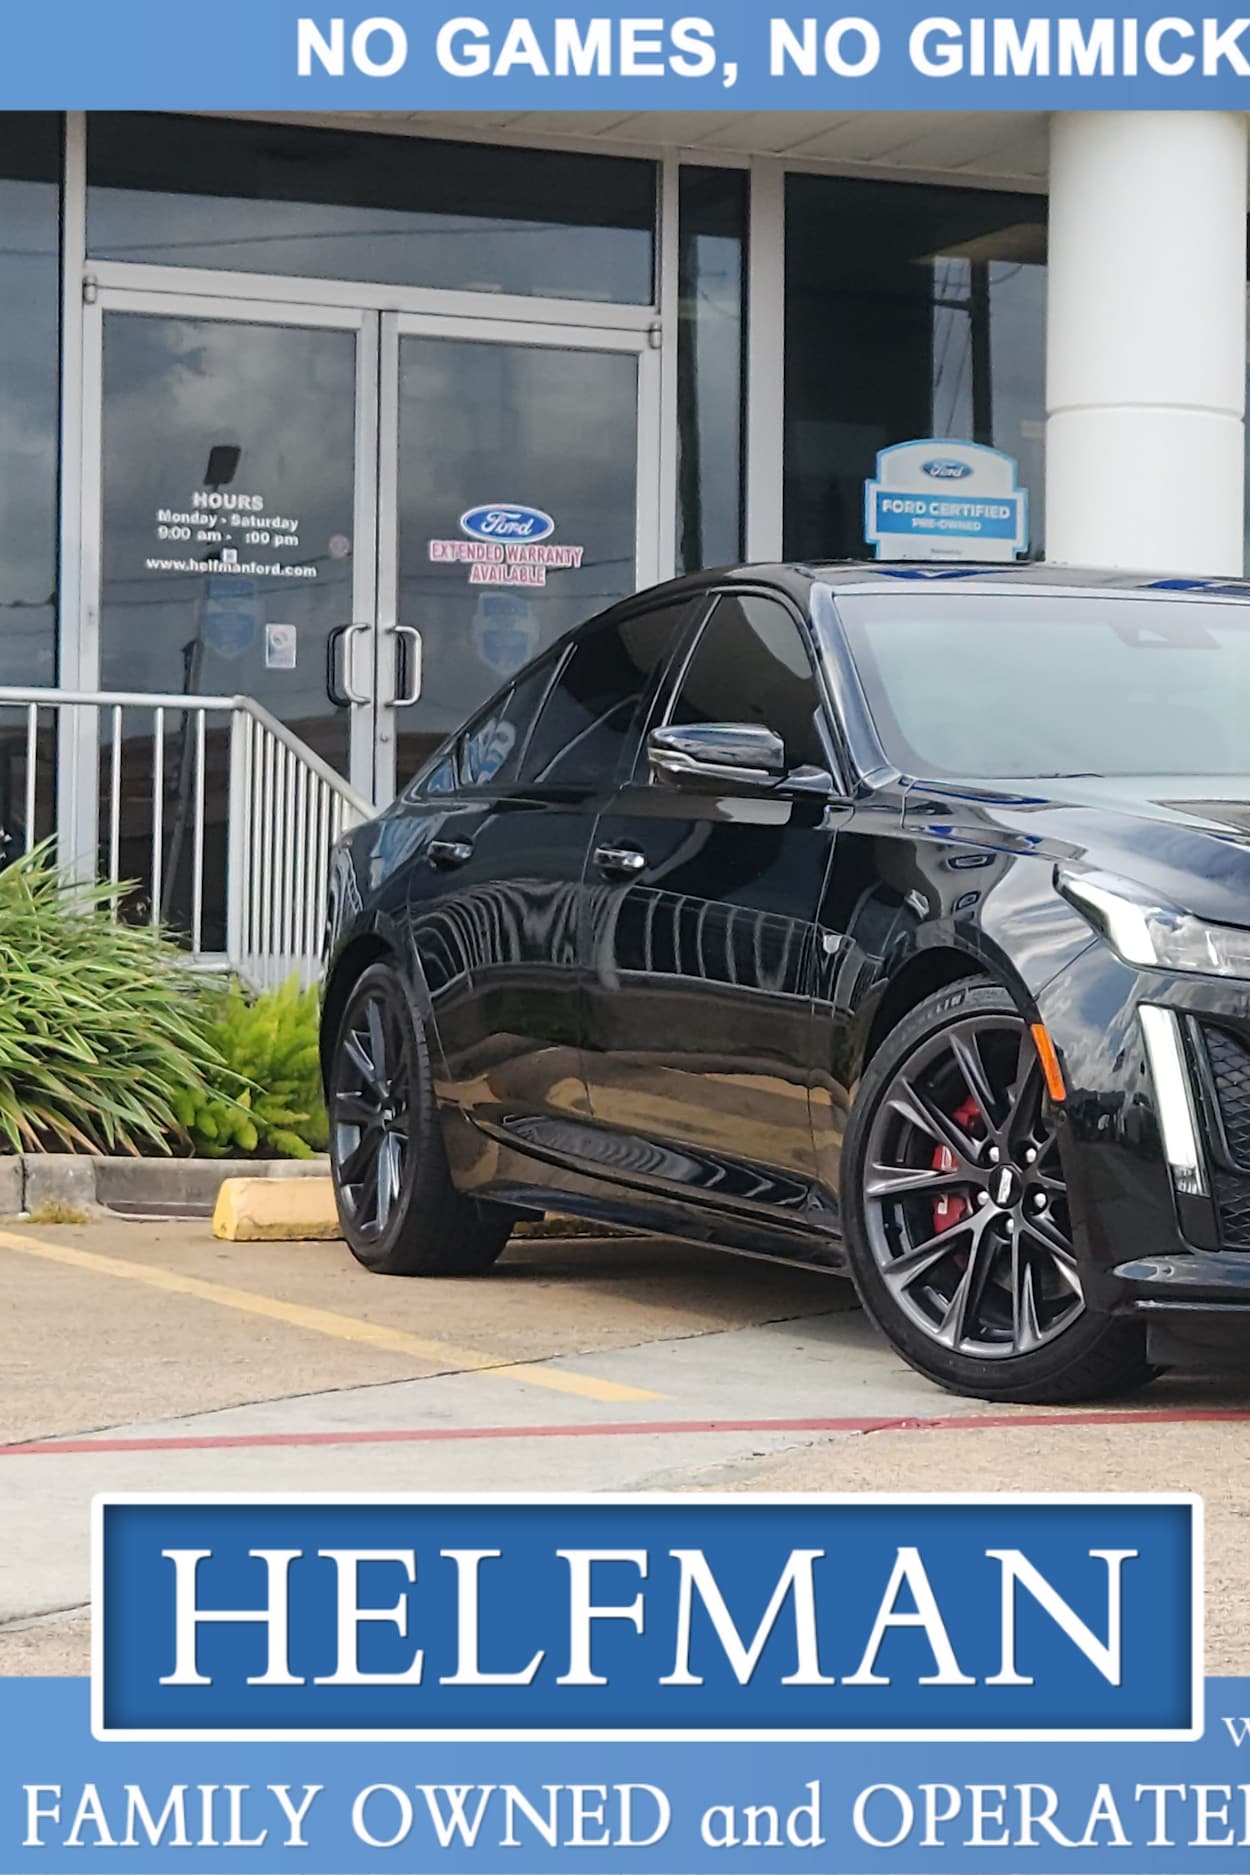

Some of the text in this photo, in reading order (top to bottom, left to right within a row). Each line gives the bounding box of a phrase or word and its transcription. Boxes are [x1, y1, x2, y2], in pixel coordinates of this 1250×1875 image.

[192, 492, 264, 511] HOURS
[882, 499, 1011, 519] FORD CERTIFIED
[157, 509, 218, 527] Monday
[230, 514, 299, 532] Saturday
[480, 511, 534, 536] Ford
[197, 530, 222, 542] am
[274, 535, 299, 548] pm
[431, 542, 582, 567] EXTENDED WARRANTY
[146, 558, 317, 577] www.helfmanford.com
[471, 565, 545, 585] AVAILABLE
